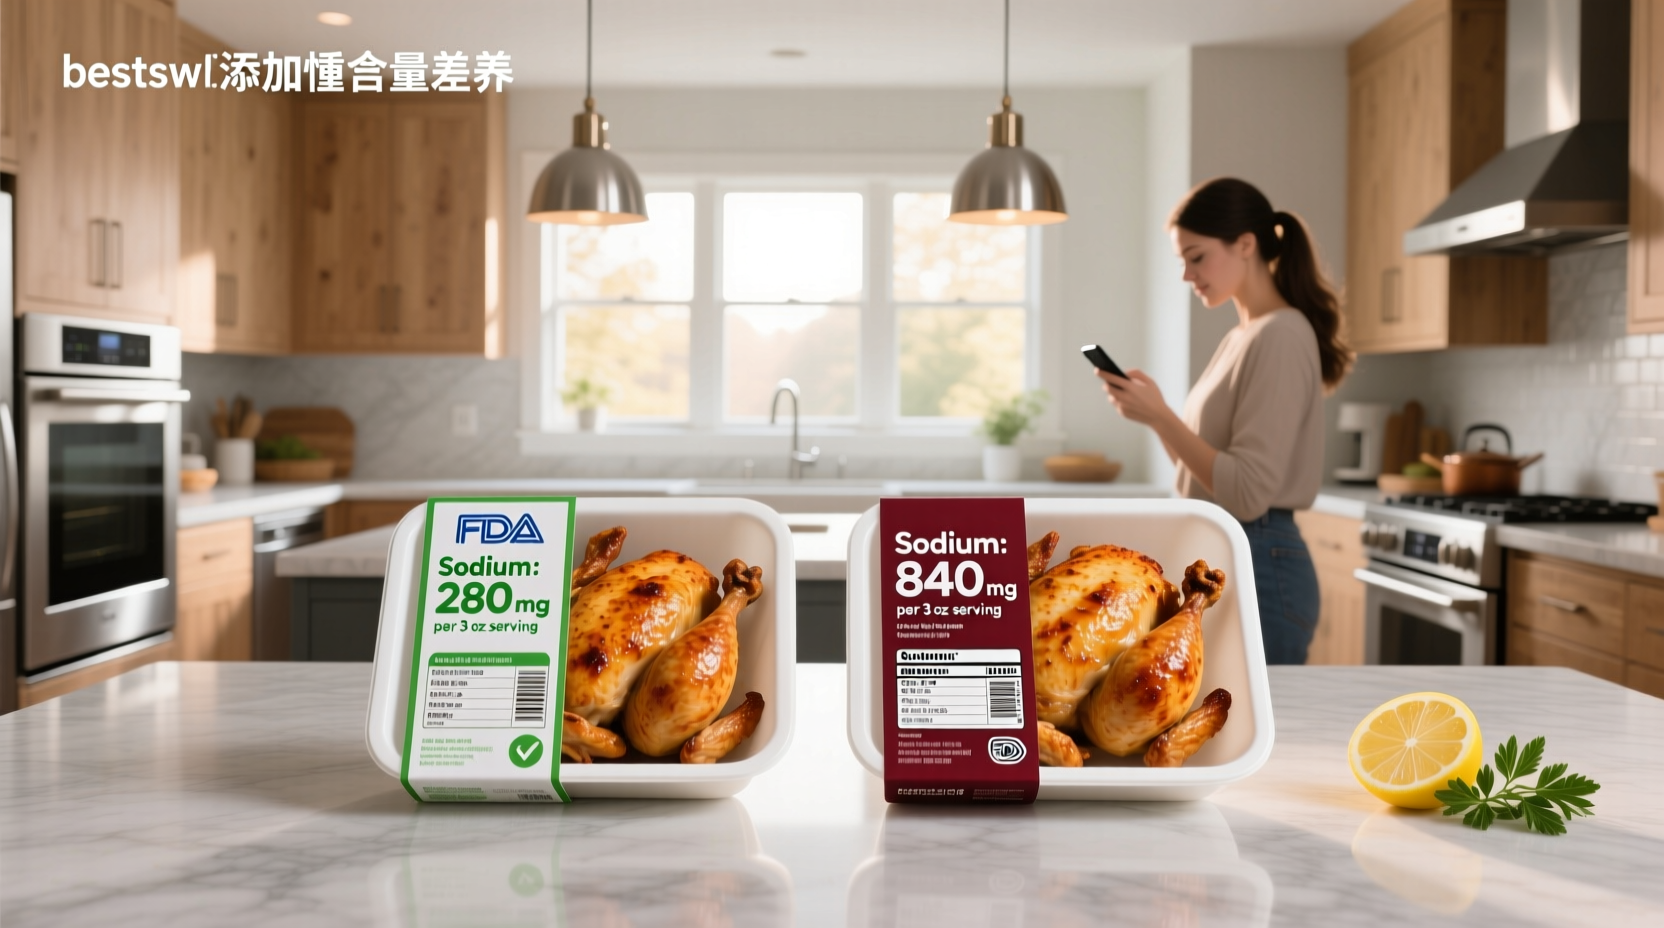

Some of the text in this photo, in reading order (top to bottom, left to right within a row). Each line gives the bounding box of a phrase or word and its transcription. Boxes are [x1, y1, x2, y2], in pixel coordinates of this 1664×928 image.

[455, 513, 545, 544] FDA
[895, 531, 1007, 554] Sodium:
[438, 555, 540, 577] Sodium:
[895, 560, 1017, 601] 840 mg
[435, 581, 550, 618] 280 mg
[897, 603, 1002, 619] per 3 oz serving
[434, 620, 538, 634] per 3 oz serving
